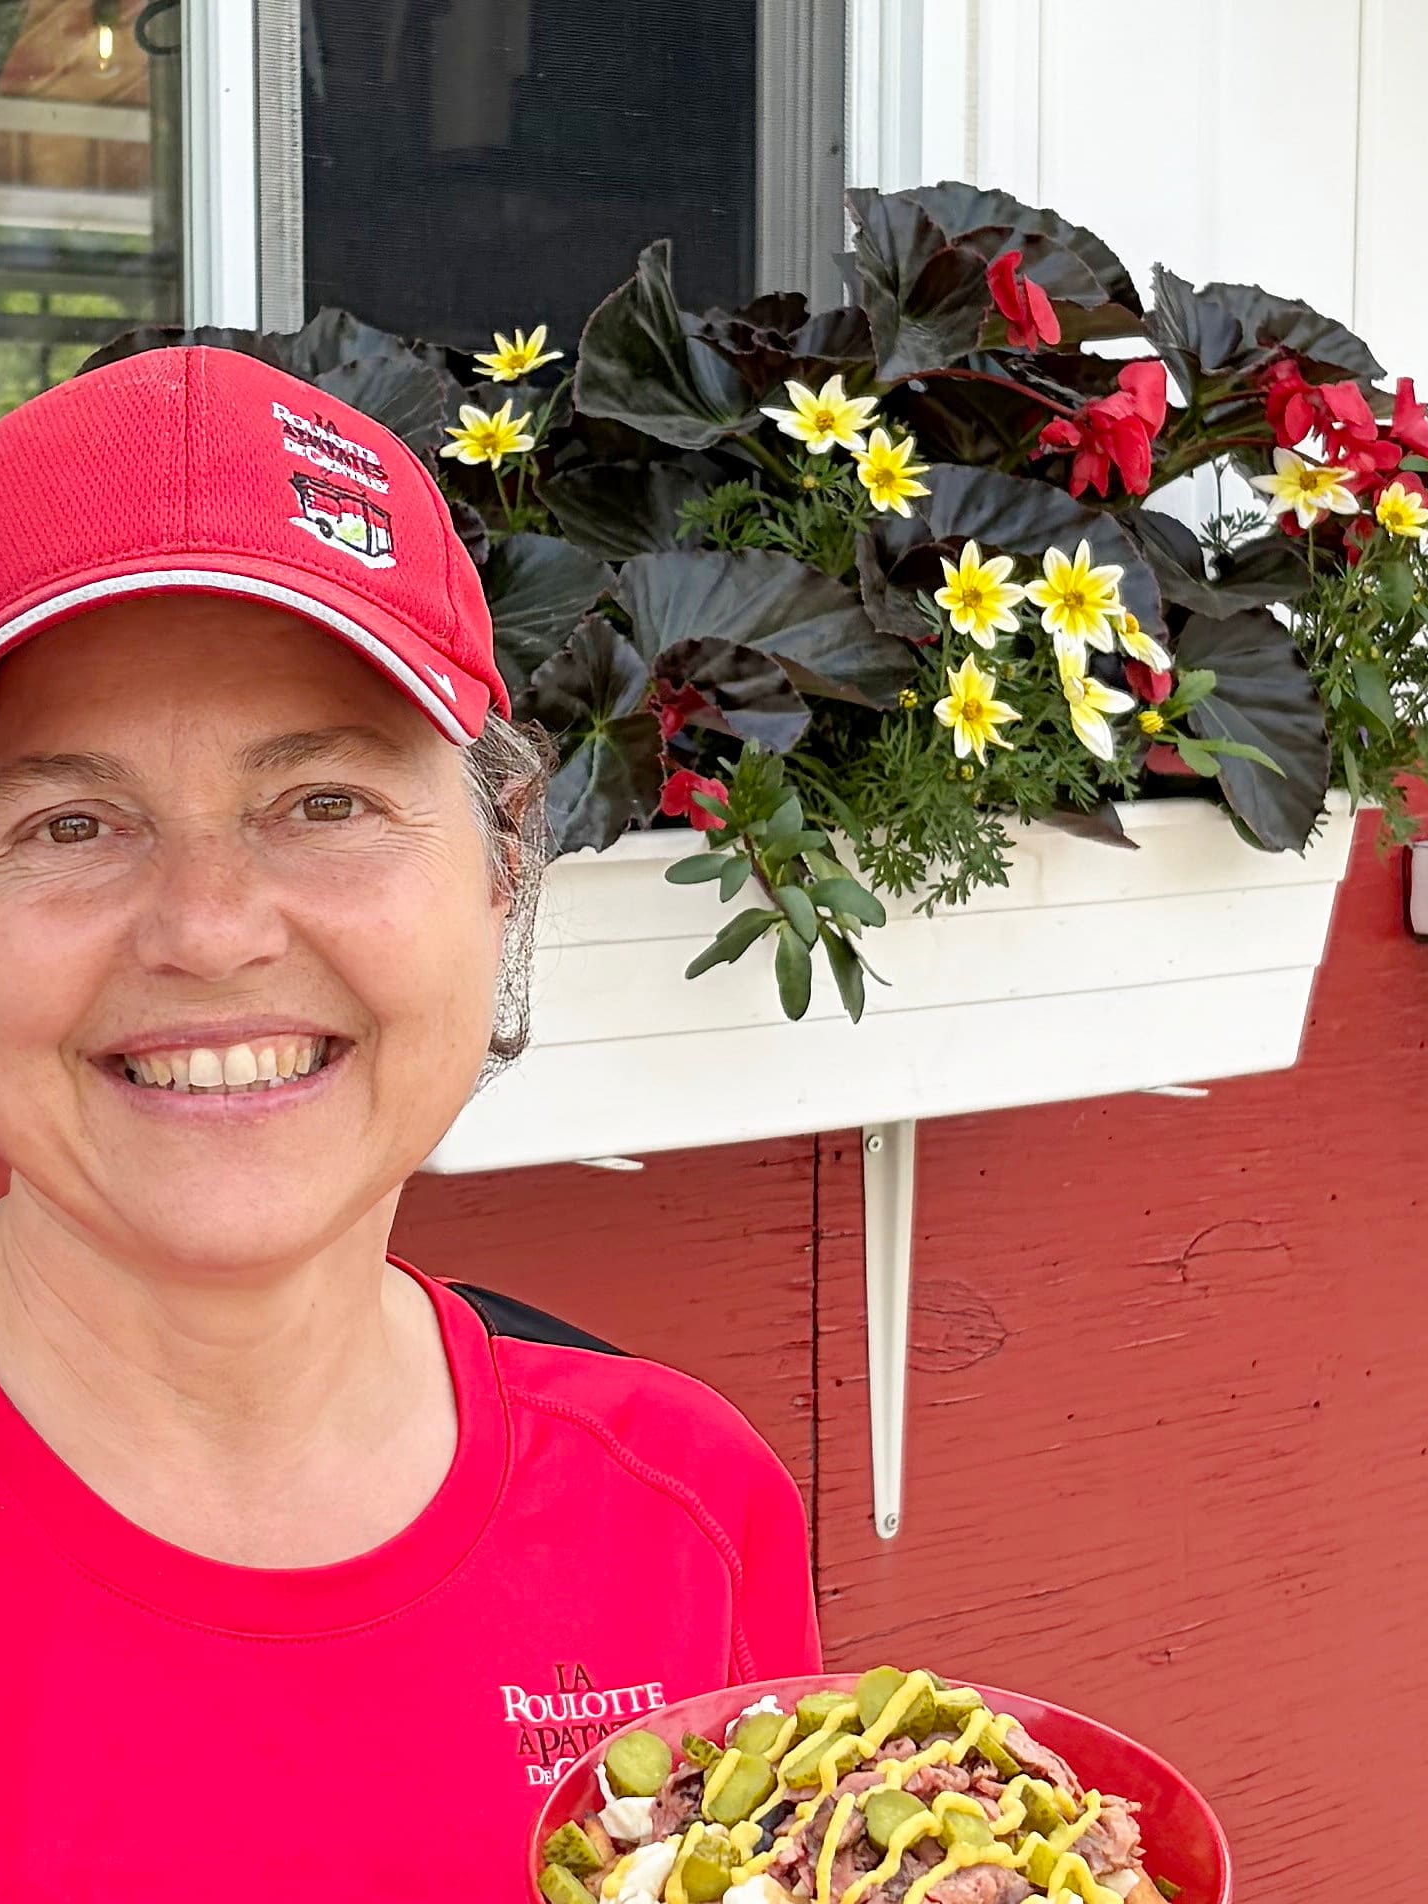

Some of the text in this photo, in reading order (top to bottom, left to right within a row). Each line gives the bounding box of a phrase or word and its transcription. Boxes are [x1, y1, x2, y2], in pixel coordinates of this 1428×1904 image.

[555, 1663, 595, 1694] LA
[499, 1681, 666, 1723] ROULOTTE
[518, 1723, 538, 1755] À
